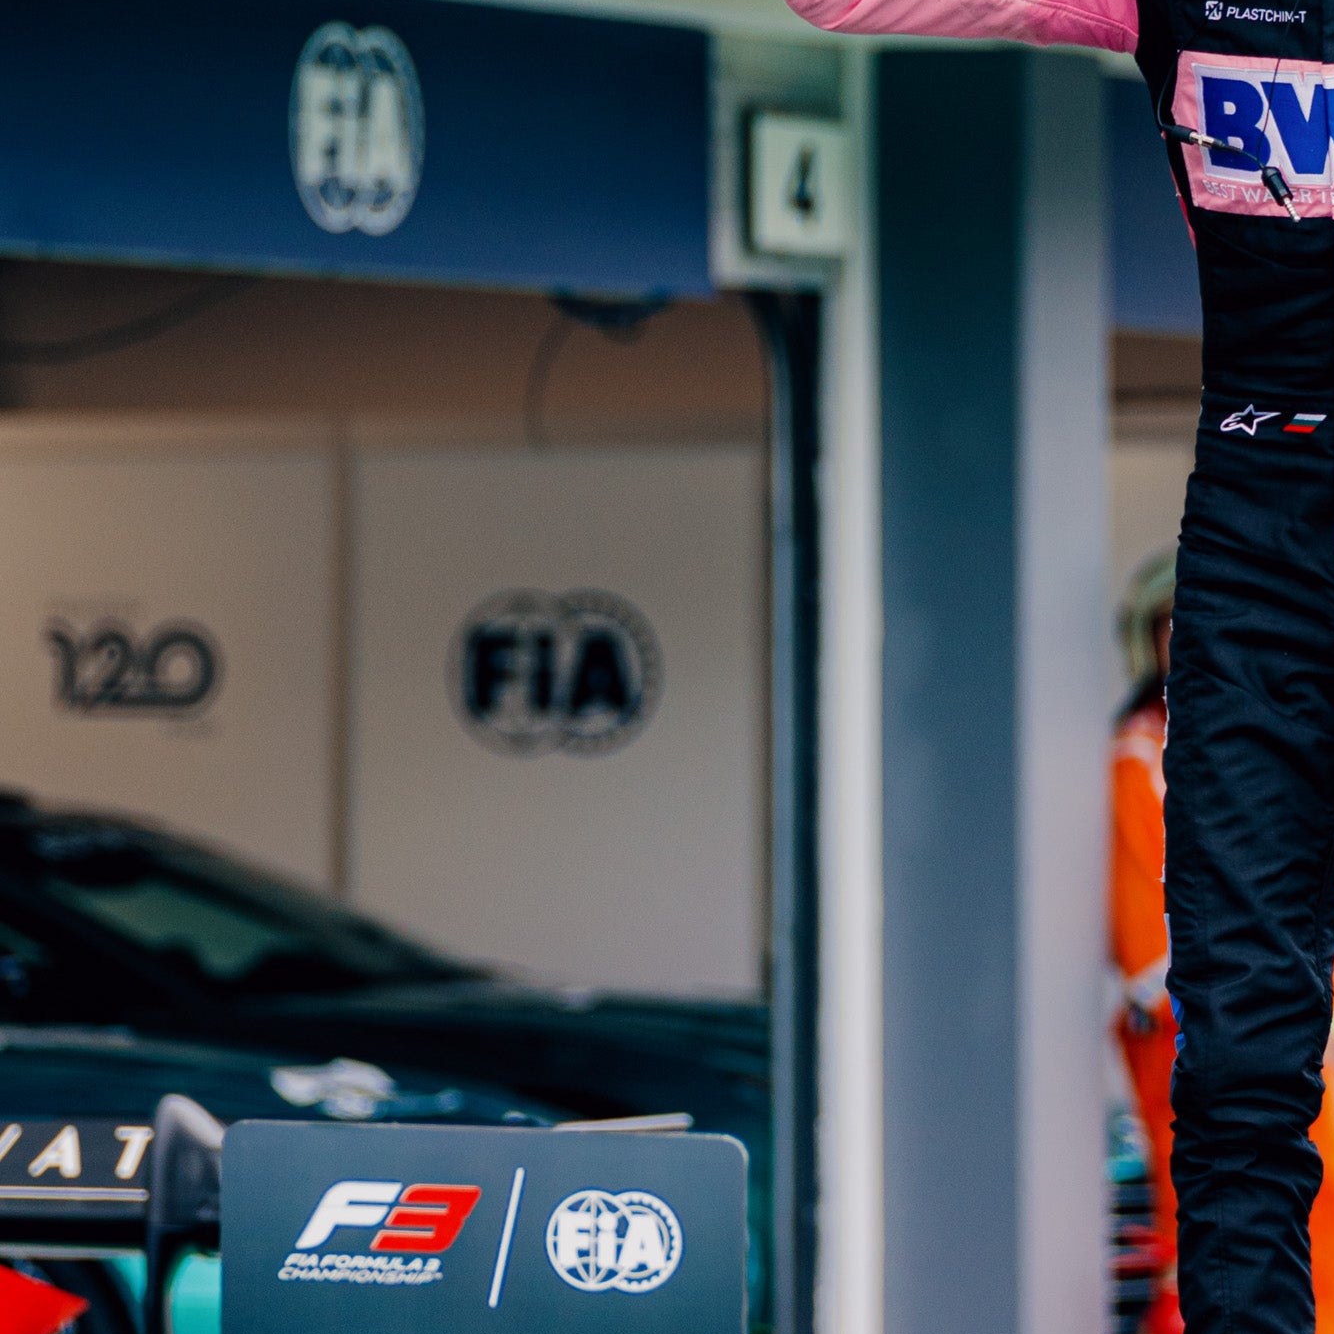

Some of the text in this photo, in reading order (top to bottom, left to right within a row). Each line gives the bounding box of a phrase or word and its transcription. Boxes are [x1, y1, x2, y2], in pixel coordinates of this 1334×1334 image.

[1226, 6, 1307, 23] PLASTCHIM-T
[1204, 180, 1237, 202] BEST
[1240, 183, 1312, 205] WAER
[464, 627, 634, 719] FIA
[295, 1180, 481, 1254] F3
[285, 1254, 325, 1268] FIA
[325, 1254, 420, 1271] FORMULA
[278, 1267, 438, 1286] CHAMPIONSHIP
